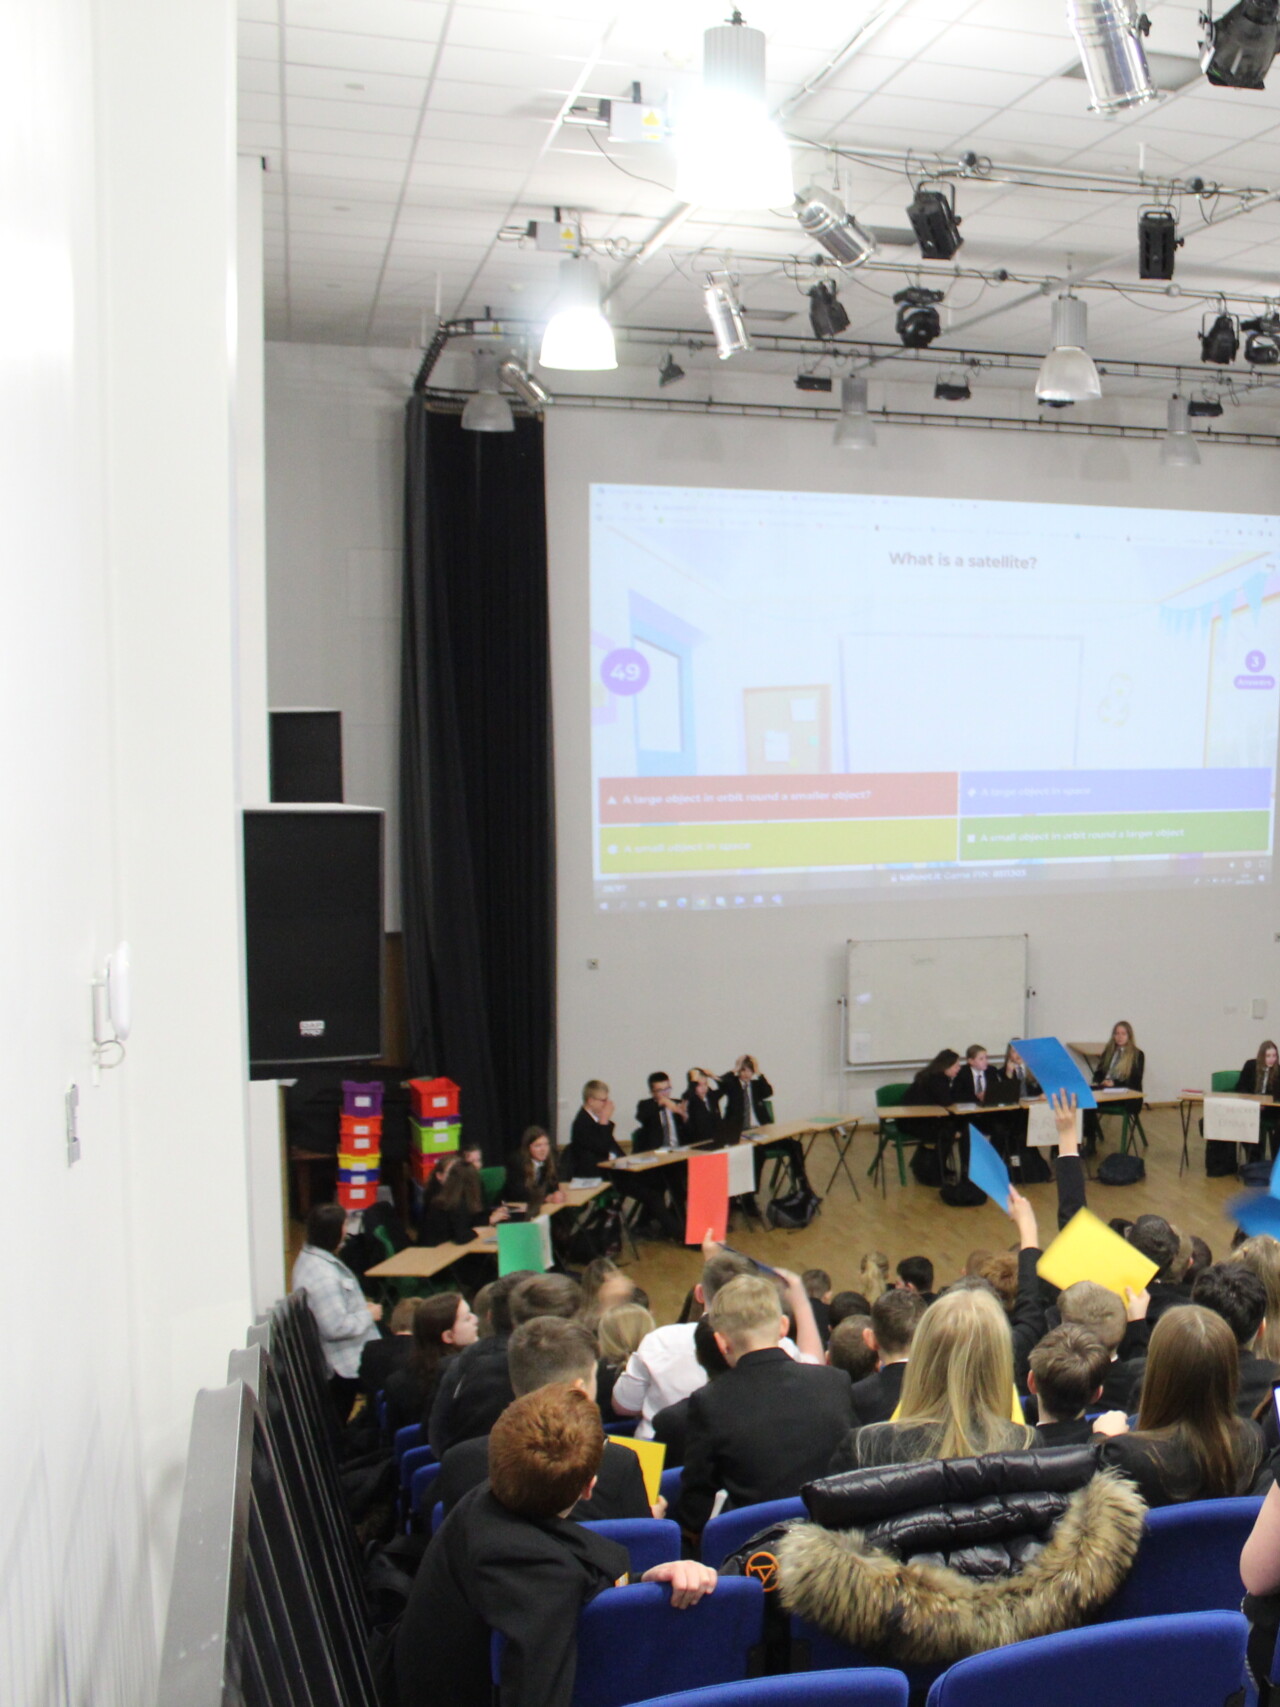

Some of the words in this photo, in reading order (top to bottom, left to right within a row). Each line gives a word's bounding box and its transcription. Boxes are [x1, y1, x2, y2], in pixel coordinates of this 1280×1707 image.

[889, 551, 934, 566] What
[938, 552, 951, 567] is
[954, 556, 964, 568] a
[968, 554, 1037, 570] satellite?
[1251, 655, 1260, 668] 3
[610, 663, 641, 681] 49
[622, 795, 632, 804] A
[633, 794, 663, 806] large
[665, 793, 702, 805] object
[703, 792, 714, 803] in
[716, 791, 743, 802] orbit
[746, 791, 780, 802] round
[781, 793, 789, 801] a
[790, 790, 830, 801] smaller
[831, 789, 872, 802] object?
[980, 834, 989, 842] A
[990, 833, 1017, 842] small
[1018, 832, 1049, 843] object
[1051, 831, 1061, 841] in
[1063, 830, 1086, 840] orbit
[1088, 830, 1116, 840] round
[1125, 829, 1153, 841] larger
[1154, 828, 1184, 840] object
[633, 843, 665, 853] small
